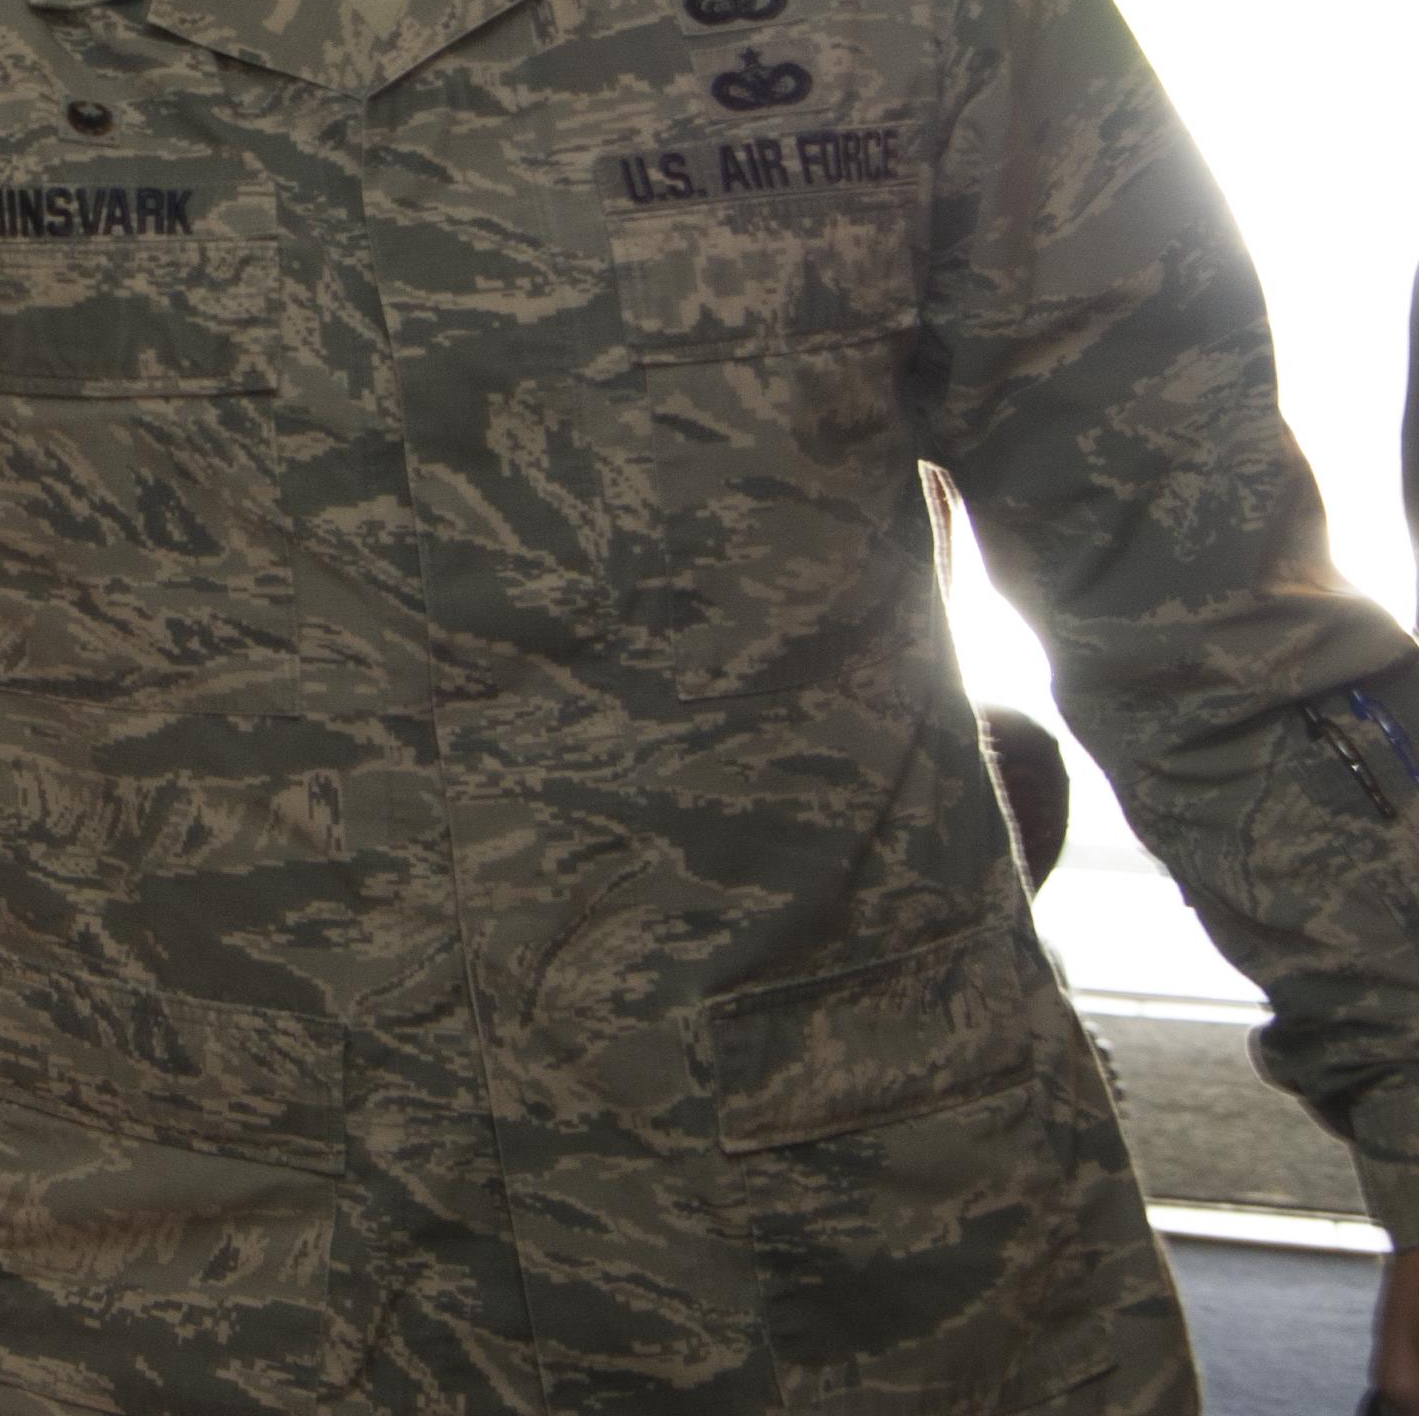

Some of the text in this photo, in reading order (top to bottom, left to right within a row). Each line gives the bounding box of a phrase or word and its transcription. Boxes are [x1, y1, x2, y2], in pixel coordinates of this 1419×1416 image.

[619, 129, 899, 203] U.S. AIR FORCE
